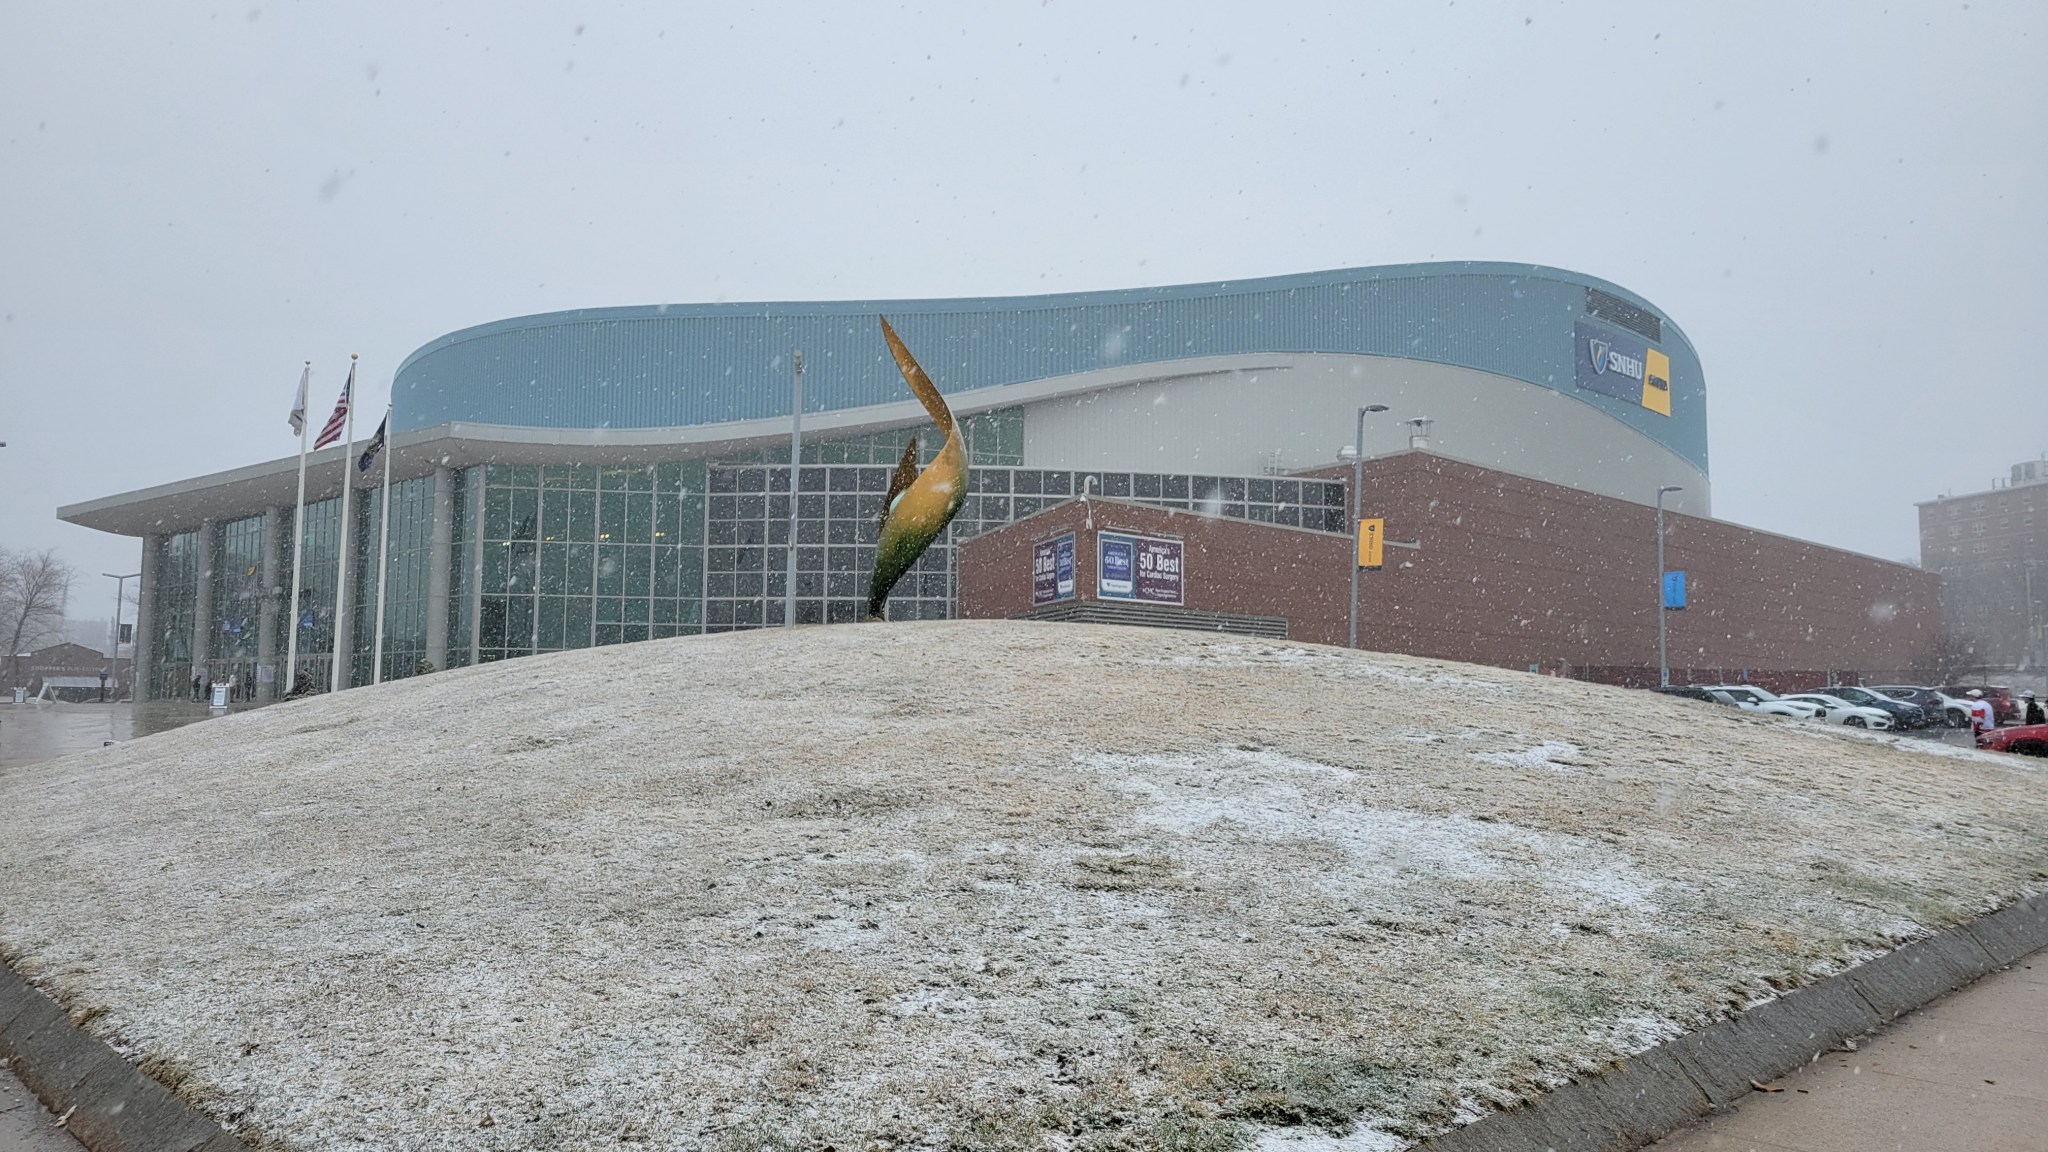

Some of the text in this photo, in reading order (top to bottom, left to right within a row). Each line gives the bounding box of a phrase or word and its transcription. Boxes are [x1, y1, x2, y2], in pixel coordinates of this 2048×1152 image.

[1609, 351, 1642, 380] SNHU
[1140, 552, 1179, 573] 50 Best
[1146, 570, 1162, 580] Cardiac
[1163, 572, 1179, 583] Surgery
